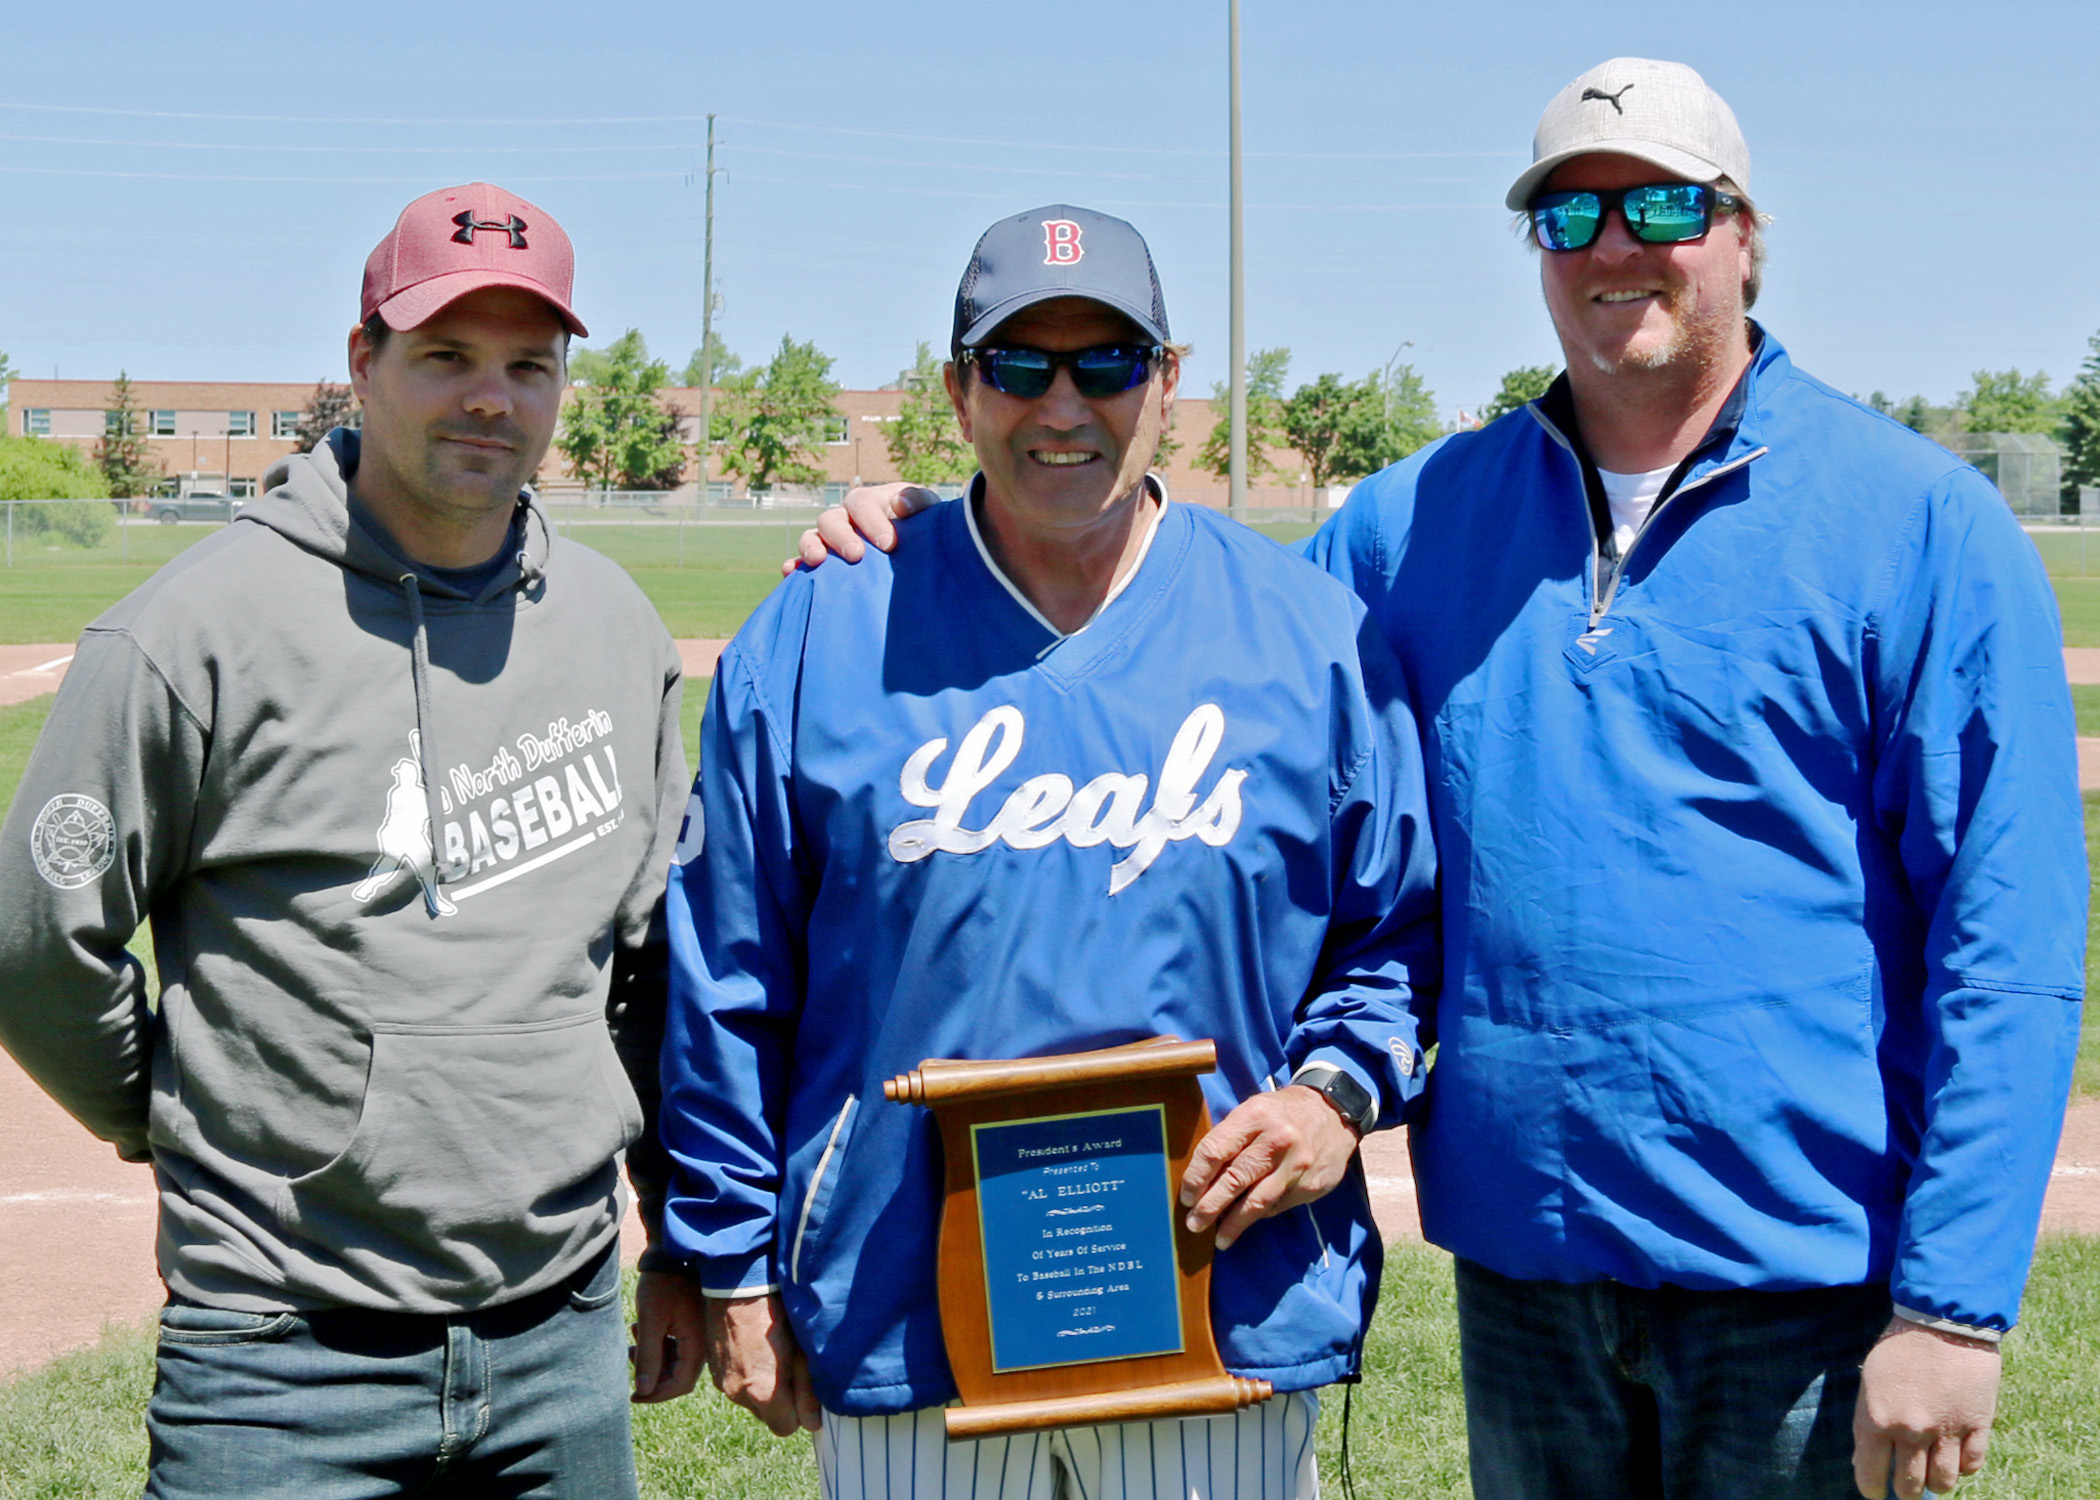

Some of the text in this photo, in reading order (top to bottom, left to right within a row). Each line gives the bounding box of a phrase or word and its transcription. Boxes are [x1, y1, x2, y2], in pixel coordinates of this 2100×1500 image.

[1041, 220, 1085, 265] B
[449, 709, 613, 805] North Dufferin
[889, 703, 1249, 897] Leafs
[1082, 1139, 1122, 1151] Award
[1043, 1164, 1088, 1176] Presented
[1042, 1224, 1113, 1238] In Recognition
[1032, 1243, 1127, 1260] Of Years Of Service
[1017, 1273, 1029, 1282] To
[1032, 1268, 1071, 1281] Baseball
[1074, 1267, 1085, 1276] In
[1087, 1265, 1105, 1275] The
[1047, 1286, 1104, 1300] Surrounding
[1106, 1284, 1130, 1293] Area
[1073, 1306, 1096, 1317] 2021
